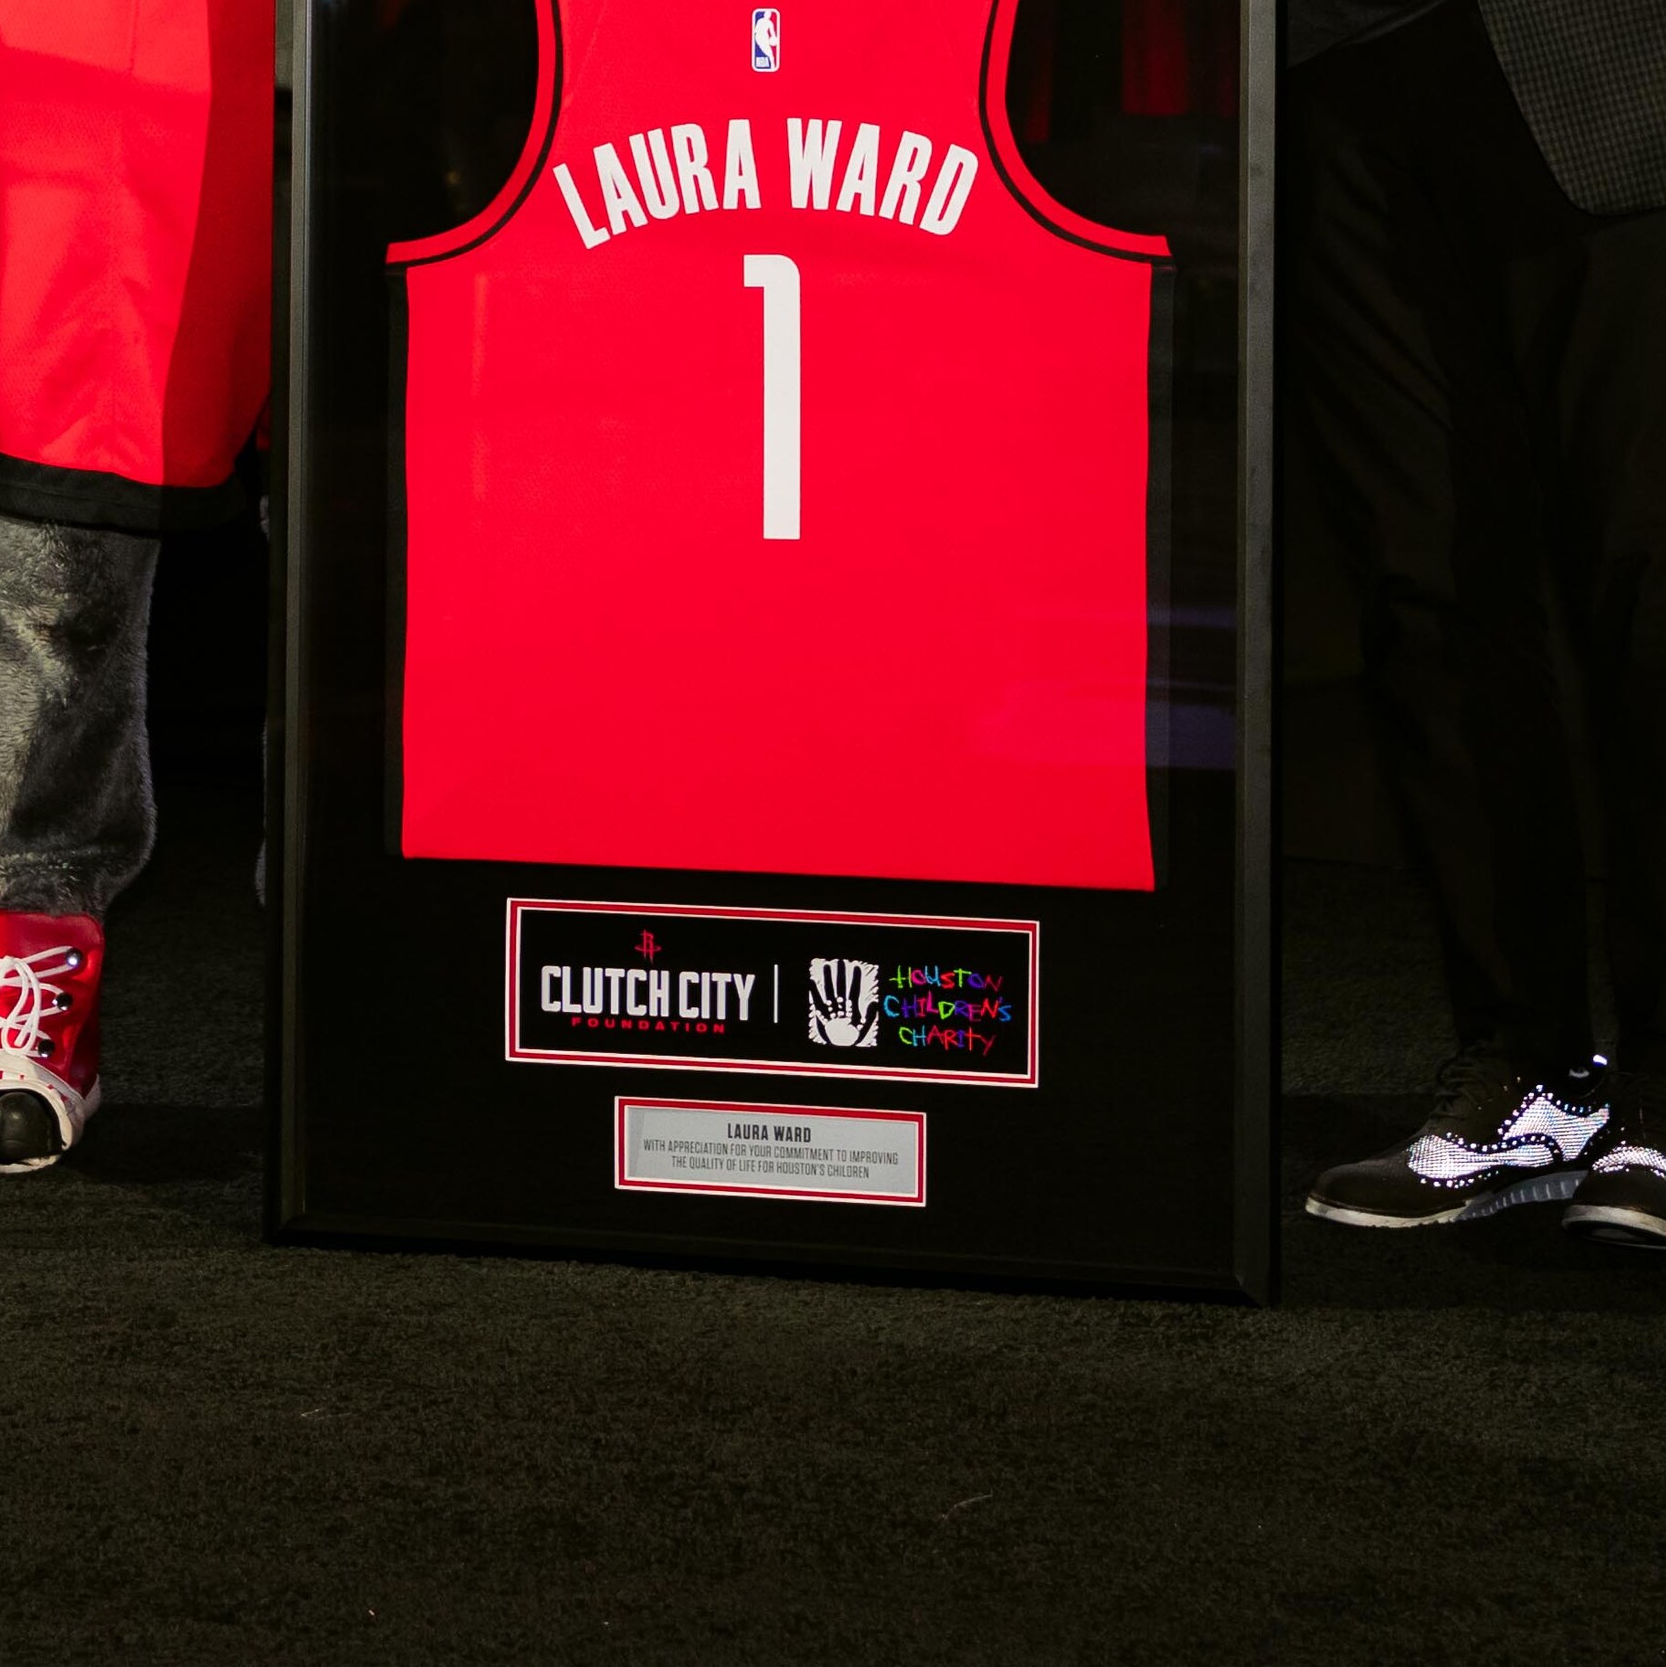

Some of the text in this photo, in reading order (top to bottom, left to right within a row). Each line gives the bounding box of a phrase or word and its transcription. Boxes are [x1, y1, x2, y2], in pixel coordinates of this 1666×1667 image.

[553, 117, 978, 249] LAURA WARD
[743, 254, 801, 540] 1
[889, 964, 1003, 992] HOUSTON
[541, 965, 756, 1021] CLUTCH CITY
[883, 990, 1012, 1022] CHILDREN'S
[571, 1017, 726, 1034] FOUNDATION
[727, 1123, 811, 1143] LAURA WARD
[643, 1139, 899, 1165] WITH APPRECIATION FOR YOUR COMMITMENT TO IMPROVING
[671, 1155, 870, 1179] THE QUALITY OF LIFE FOR HOUSTON'S CHILDREN
